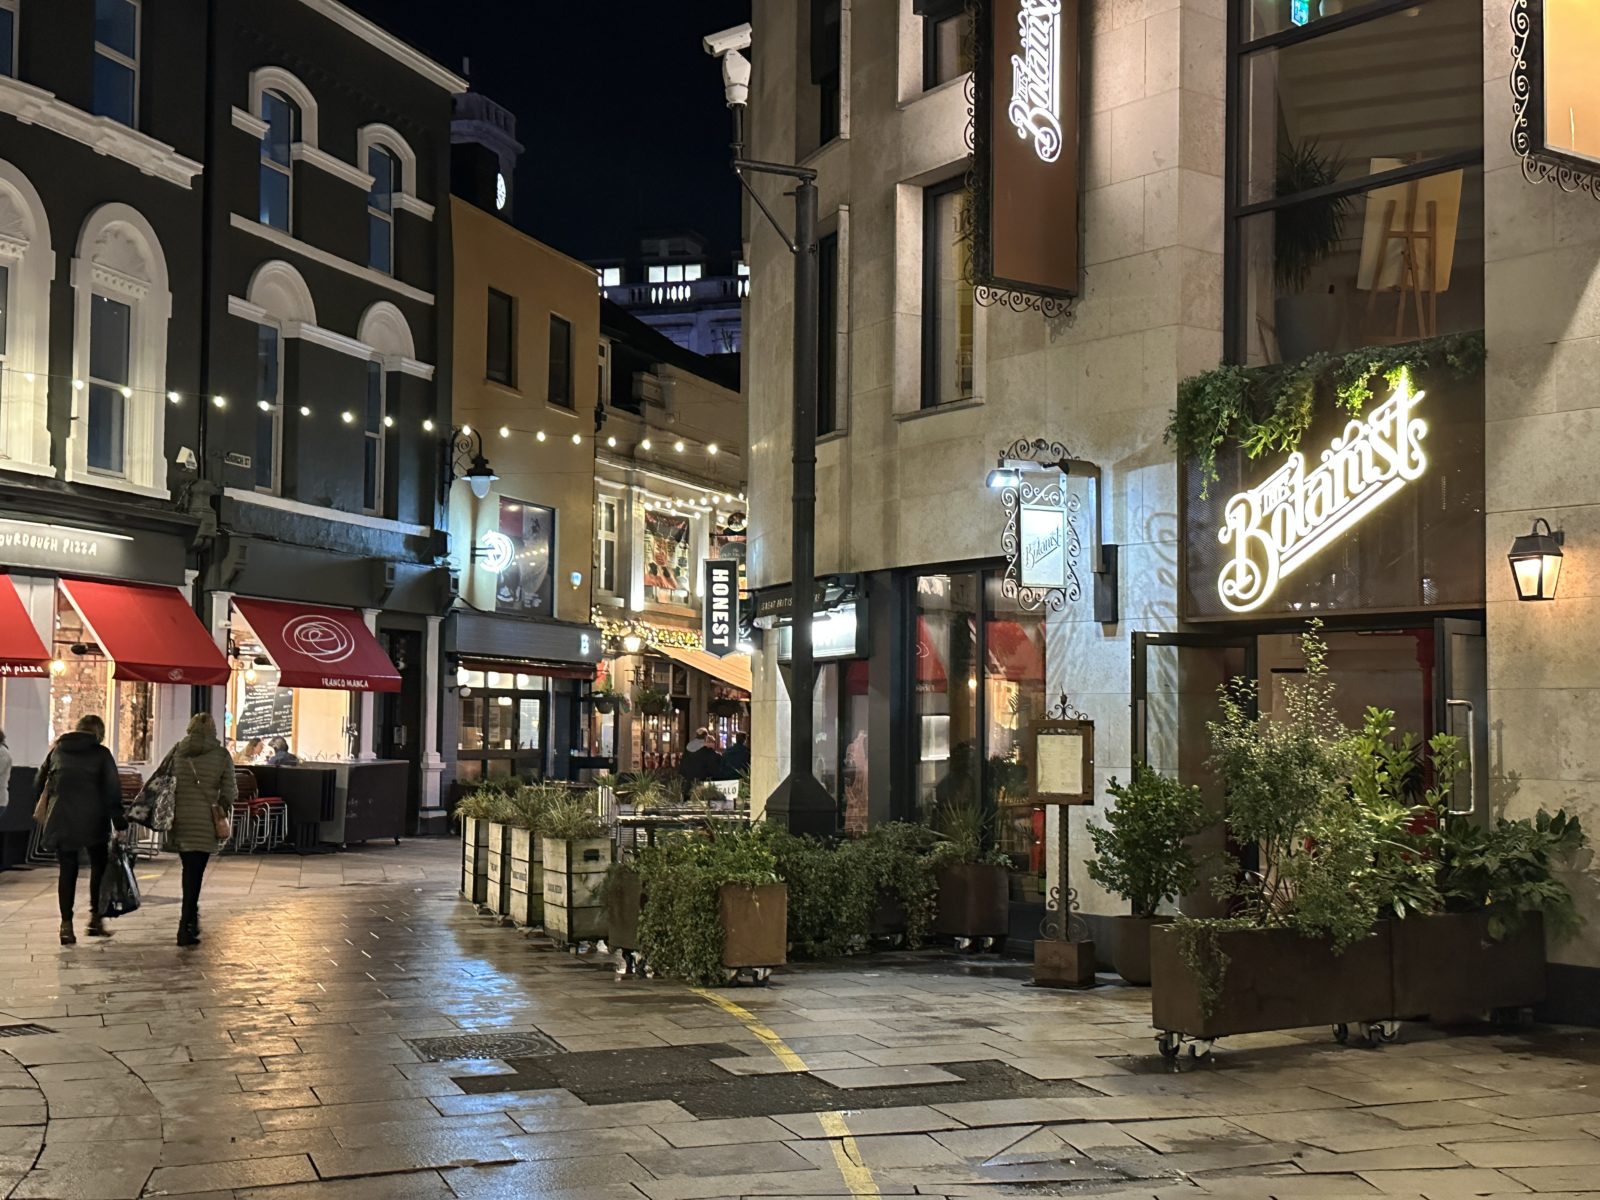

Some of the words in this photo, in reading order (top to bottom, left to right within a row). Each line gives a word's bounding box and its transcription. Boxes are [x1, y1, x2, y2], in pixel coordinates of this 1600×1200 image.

[1218, 367, 1428, 613] Botanist
[0, 532, 58, 552] OURDOUGH
[62, 539, 97, 556] PIZZA
[712, 568, 730, 648] HONEST
[14, 664, 44, 676] pizza
[321, 677, 346, 688] FRANCO
[346, 679, 369, 689] MANCA
